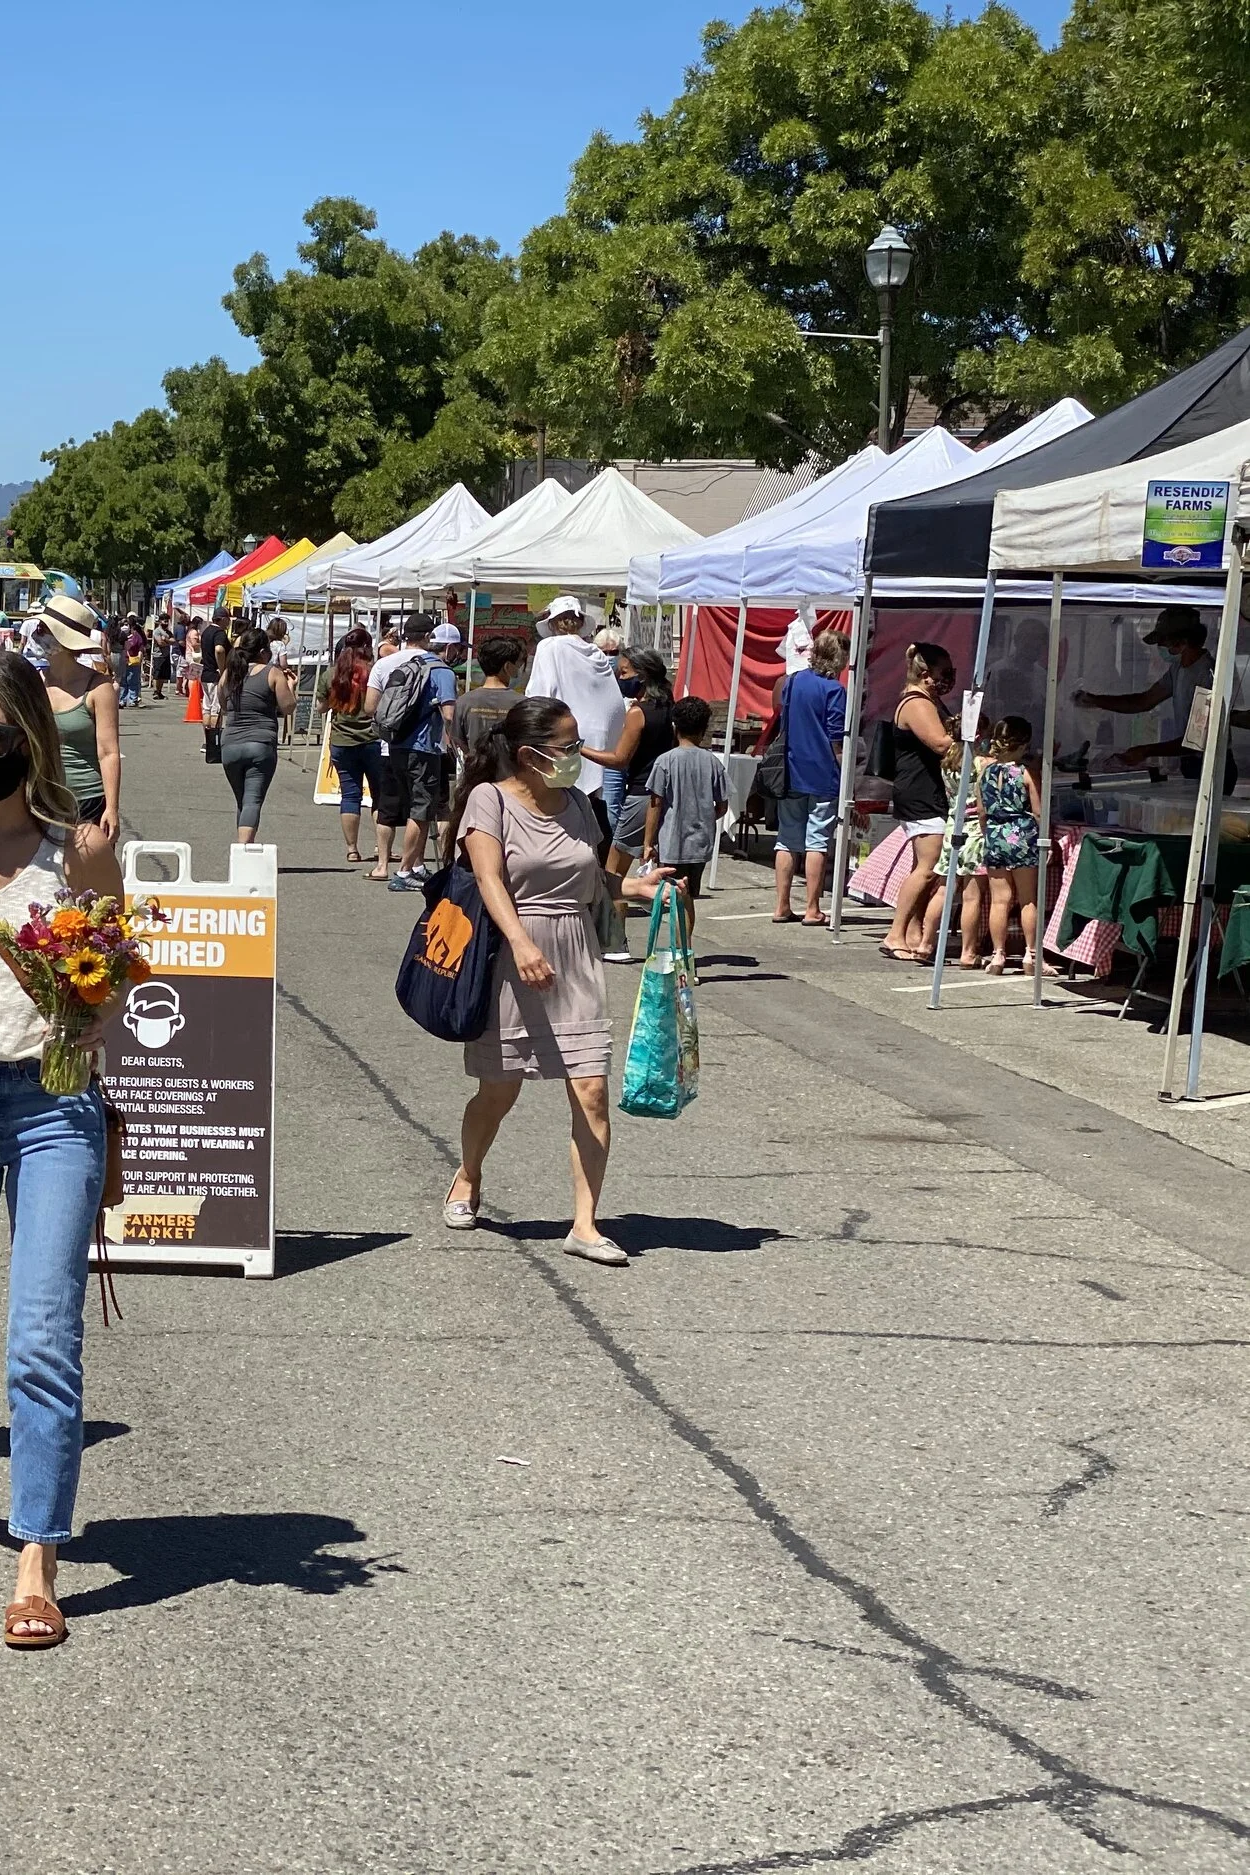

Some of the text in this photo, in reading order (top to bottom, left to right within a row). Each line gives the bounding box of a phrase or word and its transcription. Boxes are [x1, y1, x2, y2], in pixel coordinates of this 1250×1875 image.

[1154, 486, 1224, 498] RESENDIZ
[1165, 500, 1212, 511] FARMS
[135, 939, 226, 967] UIRED
[121, 1056, 185, 1069] DEAR GUESTS,
[119, 1077, 163, 1088] REQUIRES
[164, 1078, 199, 1089] GUESTS
[201, 1079, 209, 1089] &
[210, 1080, 255, 1091] WORKERS
[130, 1090, 153, 1100] FACE
[154, 1090, 204, 1102] COVERINGS
[206, 1092, 218, 1102] AT
[148, 1103, 206, 1115] BUSINESSES.
[153, 1124, 178, 1135] THAT
[179, 1125, 237, 1137] BUSINESSES
[238, 1127, 266, 1138] MUST
[127, 1136, 139, 1147] TO
[140, 1137, 179, 1148] ANYONE
[180, 1138, 200, 1149] NOT
[201, 1139, 246, 1150] WEARING
[246, 1140, 255, 1150] A
[139, 1150, 188, 1161] COVERING.
[145, 1171, 187, 1183] SUPPORT
[187, 1172, 198, 1183] IN
[199, 1173, 255, 1184] PROTECTING
[137, 1184, 155, 1194] ARE
[156, 1184, 175, 1195] ALL
[175, 1185, 186, 1195] IN
[187, 1185, 209, 1196] THIS
[209, 1186, 259, 1198] TOGETHER.
[125, 1214, 196, 1227] FARMERS
[124, 1226, 196, 1240] MARKET
